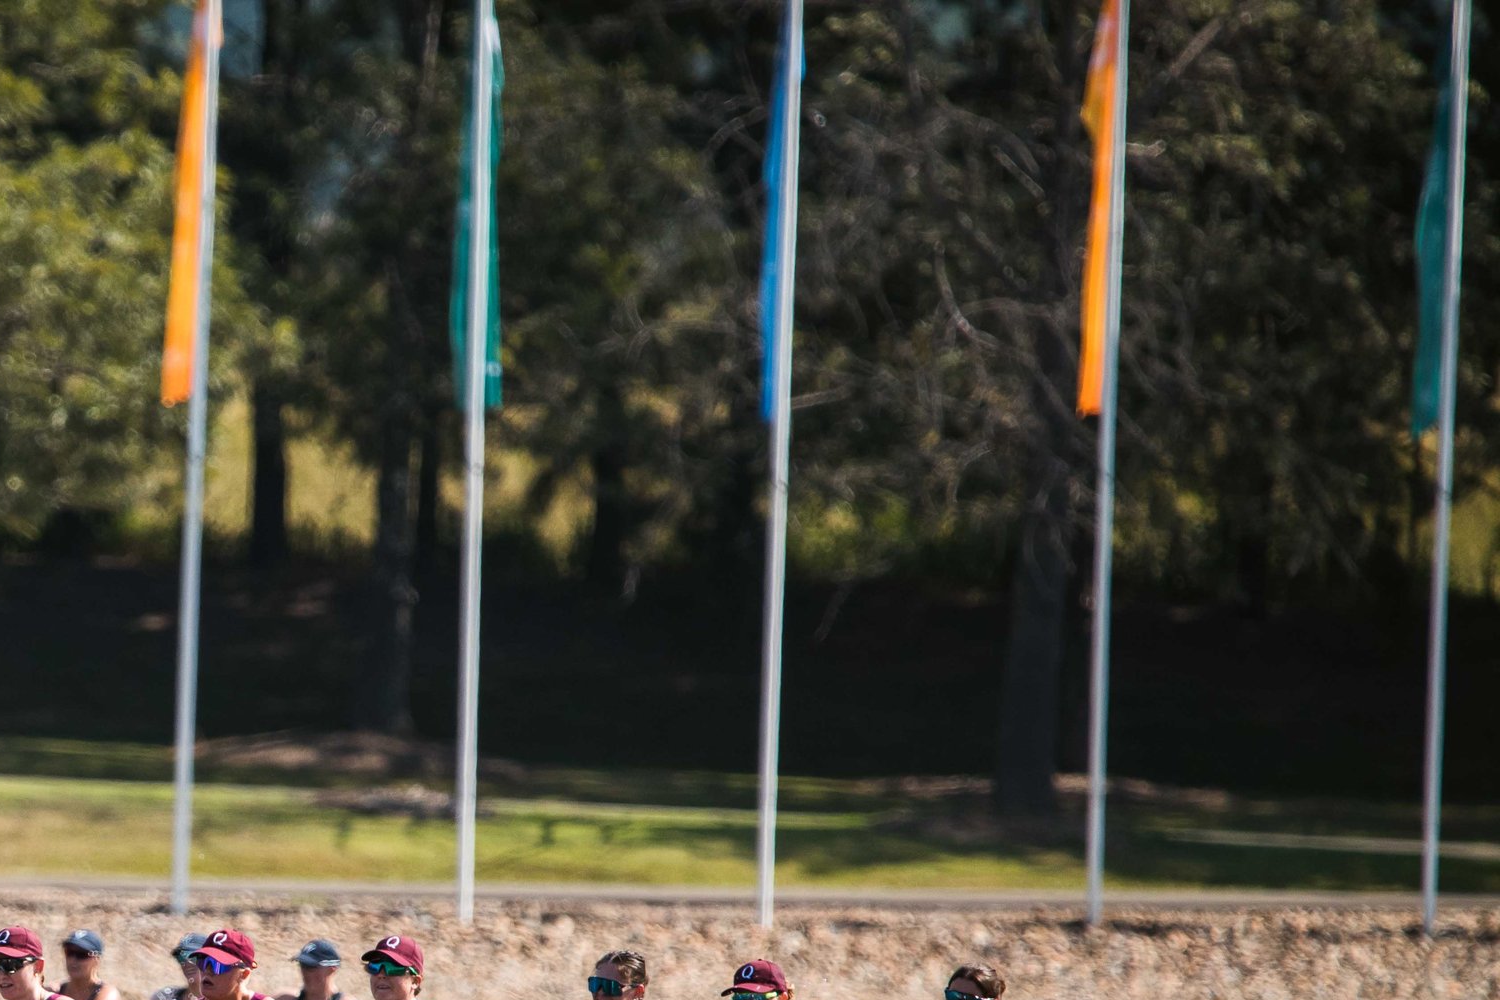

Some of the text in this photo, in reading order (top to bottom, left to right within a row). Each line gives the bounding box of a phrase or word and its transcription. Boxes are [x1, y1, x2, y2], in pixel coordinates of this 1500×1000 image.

[213, 932, 227, 945] Q
[386, 936, 400, 949] Q
[742, 965, 754, 979] Q
